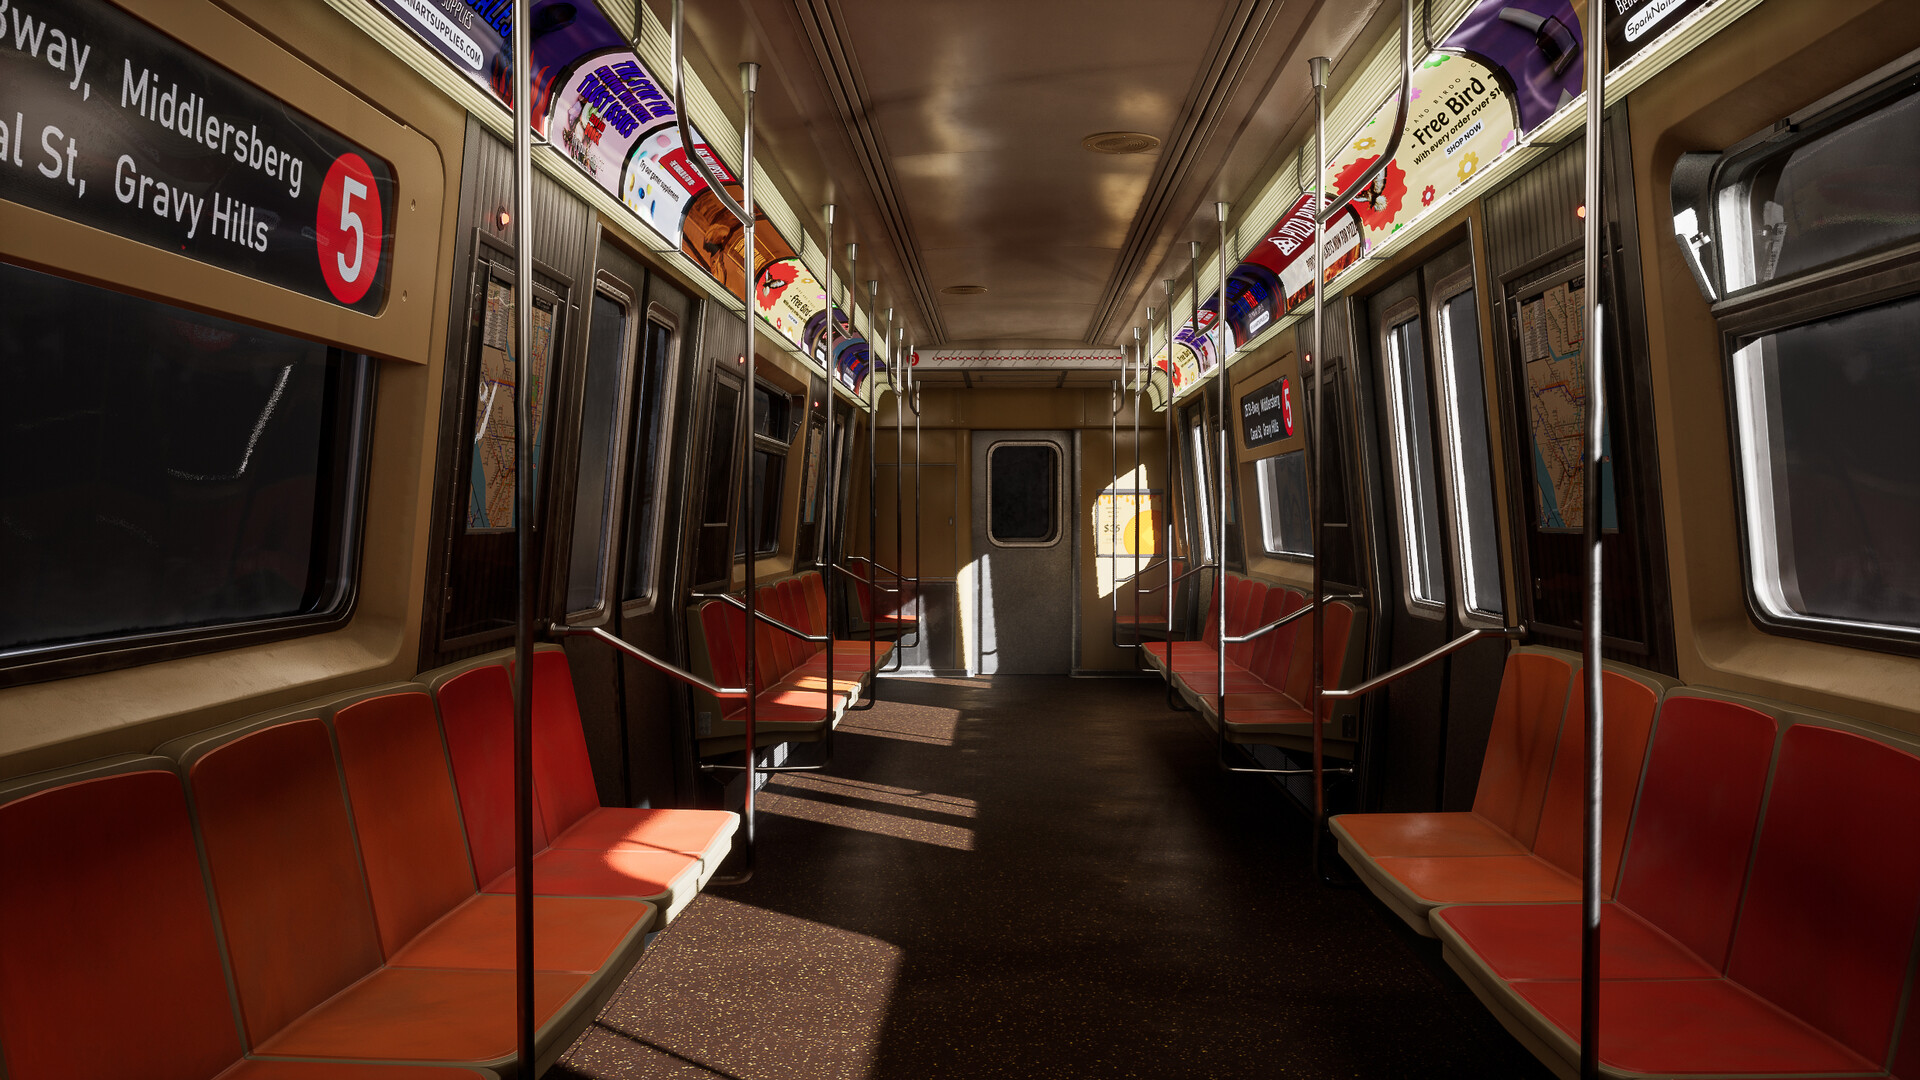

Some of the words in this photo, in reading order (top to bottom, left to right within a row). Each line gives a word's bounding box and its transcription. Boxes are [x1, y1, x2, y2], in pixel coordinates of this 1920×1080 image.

[611, 60, 647, 81] THE
[627, 79, 664, 101] STOP
[121, 58, 303, 198] Middlersberg
[576, 73, 616, 113] TRUST
[603, 101, 640, 139] ISSUES
[1412, 111, 1450, 145] Free
[1445, 77, 1486, 115] Bird
[1413, 108, 1430, 124] AND
[1413, 150, 1431, 166] With
[1430, 132, 1450, 152] every
[1450, 114, 1471, 135] order
[1471, 97, 1490, 116] over
[1446, 137, 1464, 155] SHOP
[1463, 123, 1482, 140] NOW
[37, 125, 86, 199] St,
[115, 154, 204, 239] Gravy
[211, 192, 269, 253] Hills
[337, 175, 368, 283] 5
[1278, 217, 1316, 242] PIZZA
[1284, 388, 1292, 428] 5
